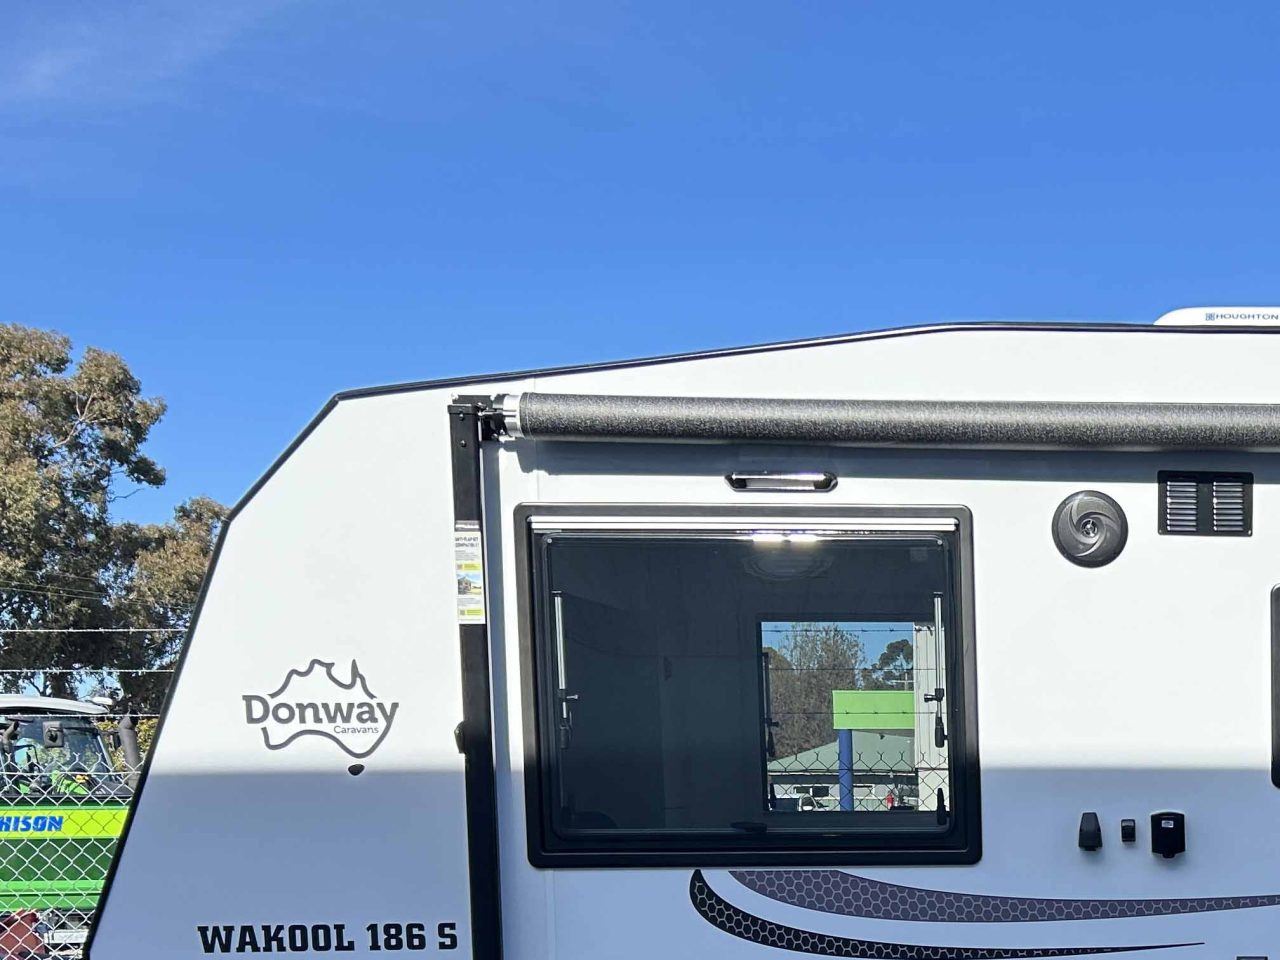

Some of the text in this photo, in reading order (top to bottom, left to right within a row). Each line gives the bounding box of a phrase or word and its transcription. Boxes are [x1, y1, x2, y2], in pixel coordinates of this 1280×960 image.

[242, 694, 400, 727] Donway
[333, 725, 379, 734] Caravans
[0, 816, 64, 832] HISON
[197, 922, 458, 953] WAKOOL 186 S
